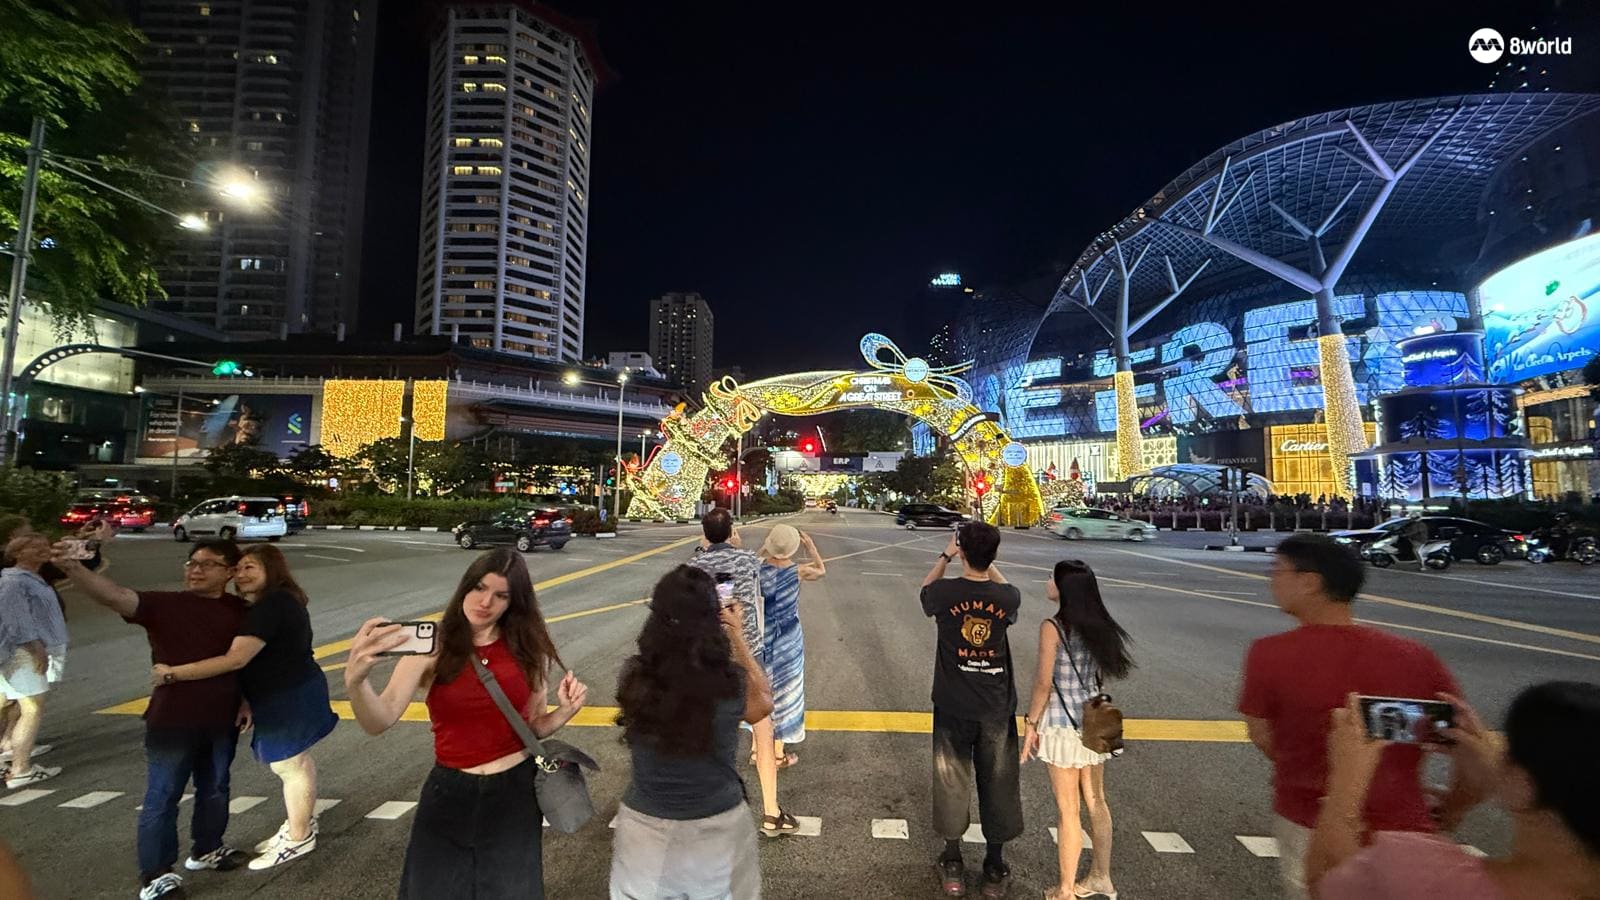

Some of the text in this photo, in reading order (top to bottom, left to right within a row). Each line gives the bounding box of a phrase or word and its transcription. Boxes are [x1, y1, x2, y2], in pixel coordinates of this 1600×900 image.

[863, 385, 878, 393] ON
[838, 391, 902, 402] A GREAT STREET
[1280, 439, 1329, 452] Cartier
[833, 457, 851, 465] ERP
[949, 600, 1007, 619] HUMAN
[958, 648, 996, 658] MADE
